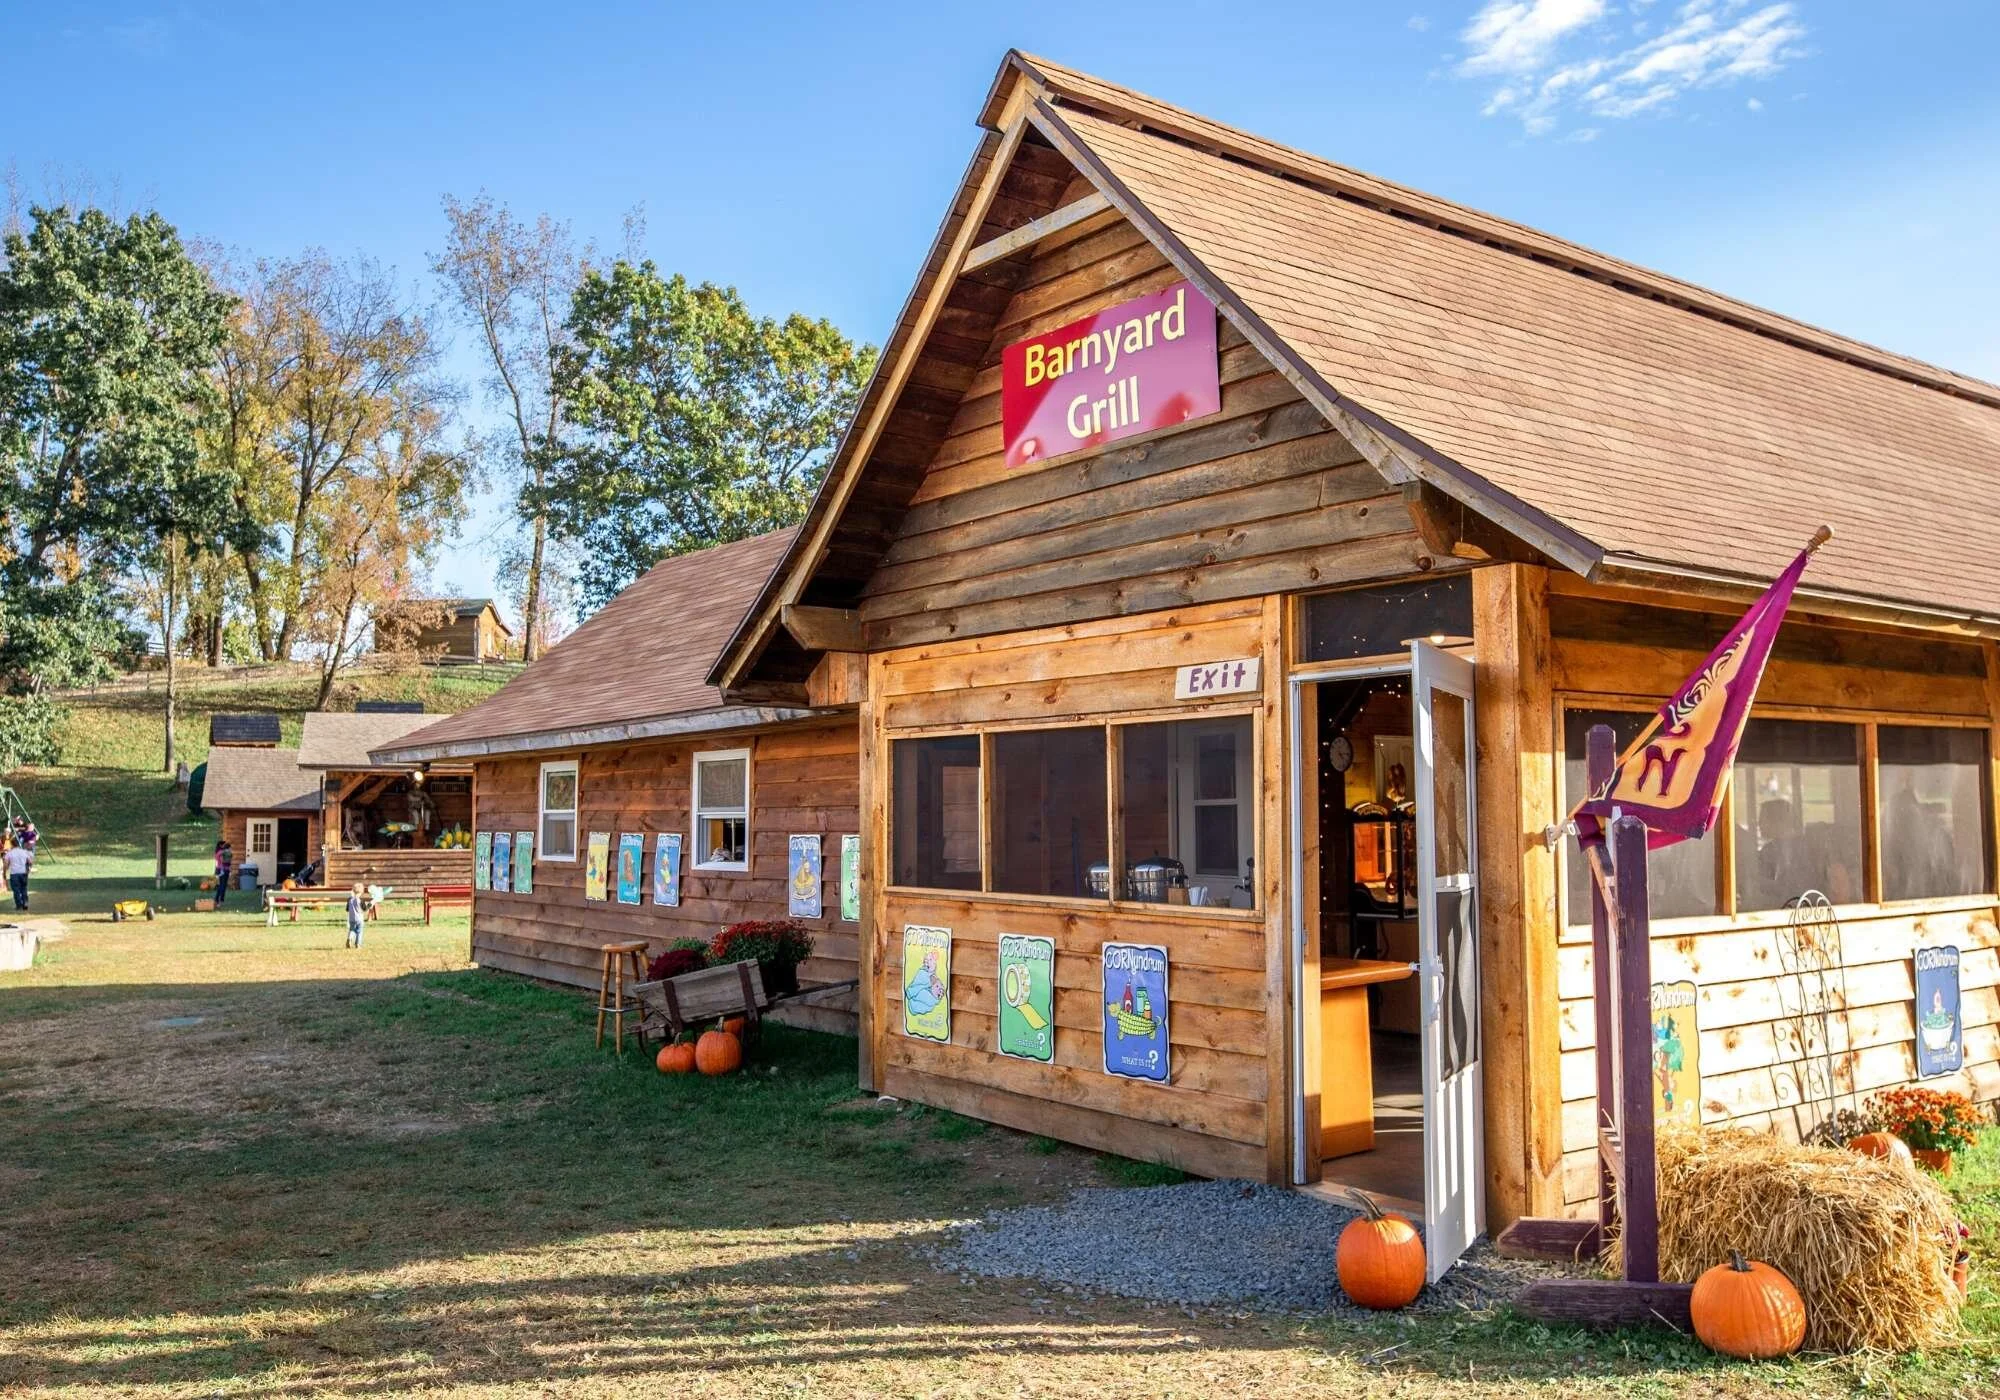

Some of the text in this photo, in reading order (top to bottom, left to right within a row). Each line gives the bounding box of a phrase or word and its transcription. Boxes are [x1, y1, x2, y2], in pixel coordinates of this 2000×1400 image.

[1025, 288, 1185, 387] Barnyard
[1066, 375, 1140, 439] Grill
[1189, 662, 1246, 693] Exit
